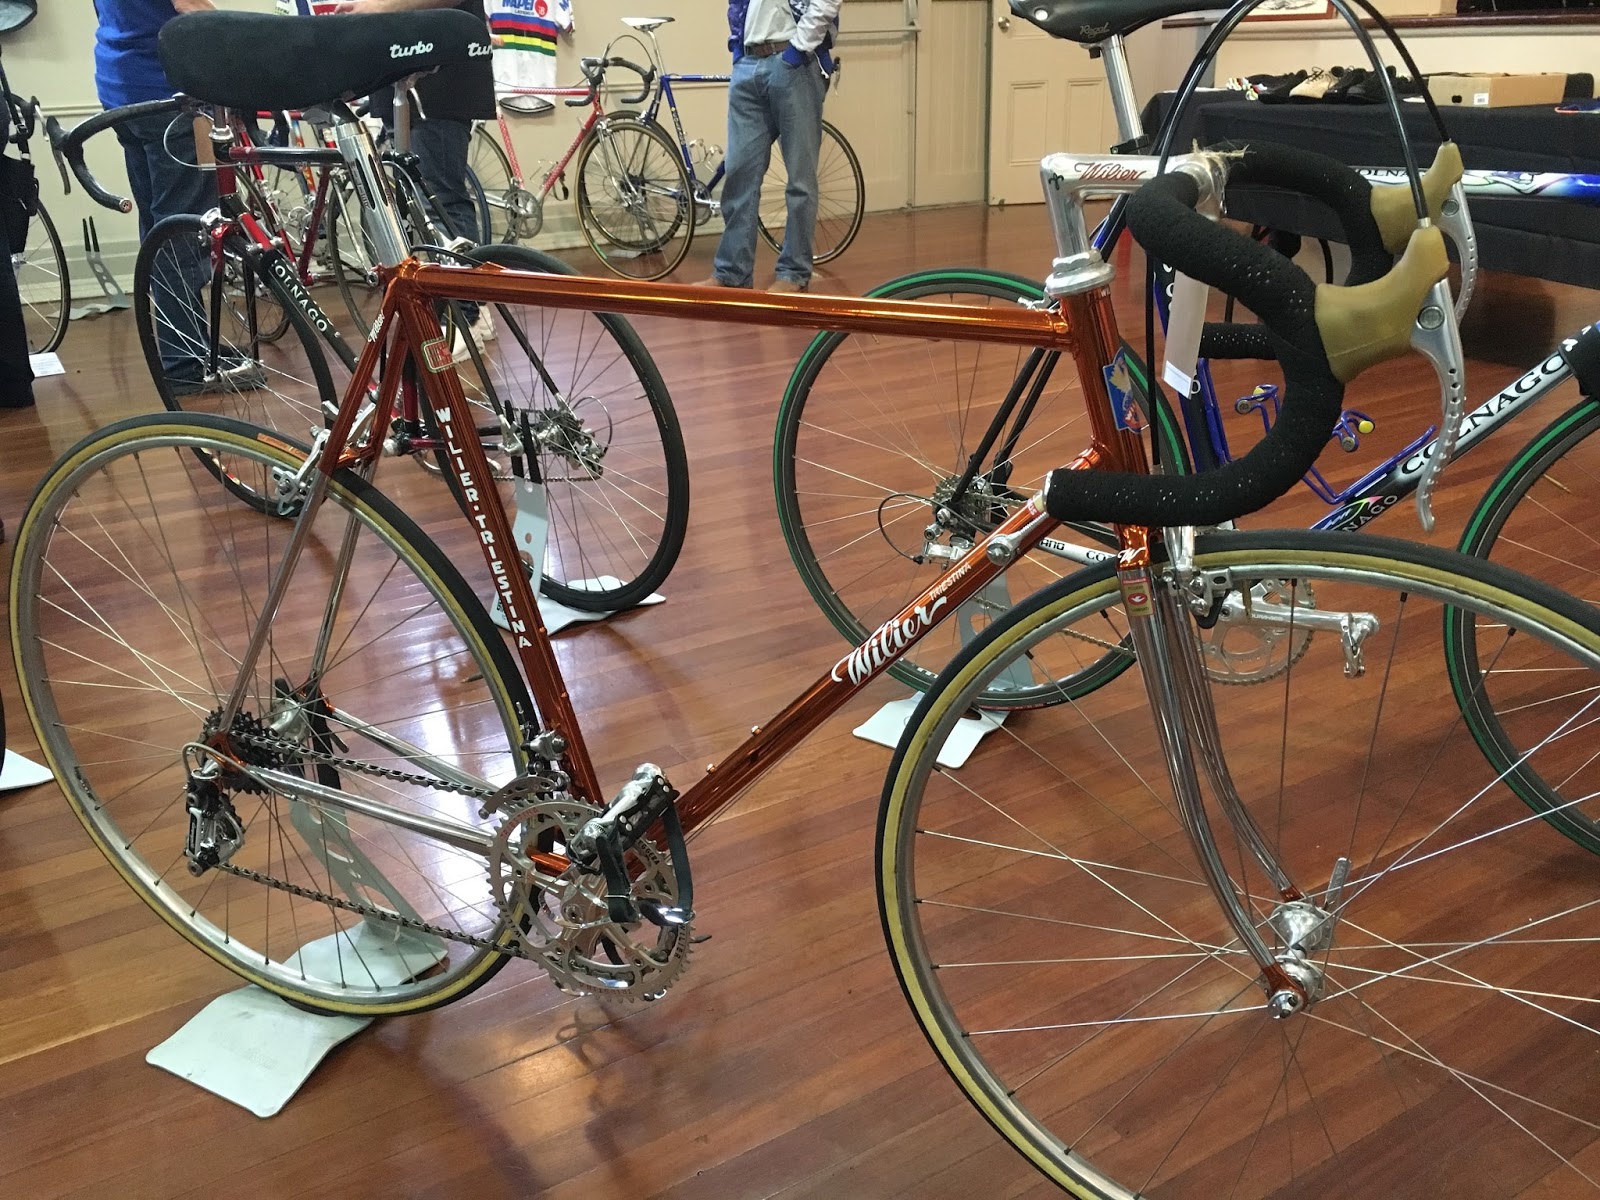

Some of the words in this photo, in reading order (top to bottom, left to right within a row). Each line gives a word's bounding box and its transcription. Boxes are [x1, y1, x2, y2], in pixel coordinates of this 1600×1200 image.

[389, 41, 434, 59] turbo
[467, 42, 493, 57] tur
[1074, 161, 1147, 181] Wilier
[273, 261, 328, 332] OLNAGO
[1341, 495, 1398, 533] NAGO
[928, 561, 972, 601] TRIESTINA
[831, 596, 947, 686] Wilier
